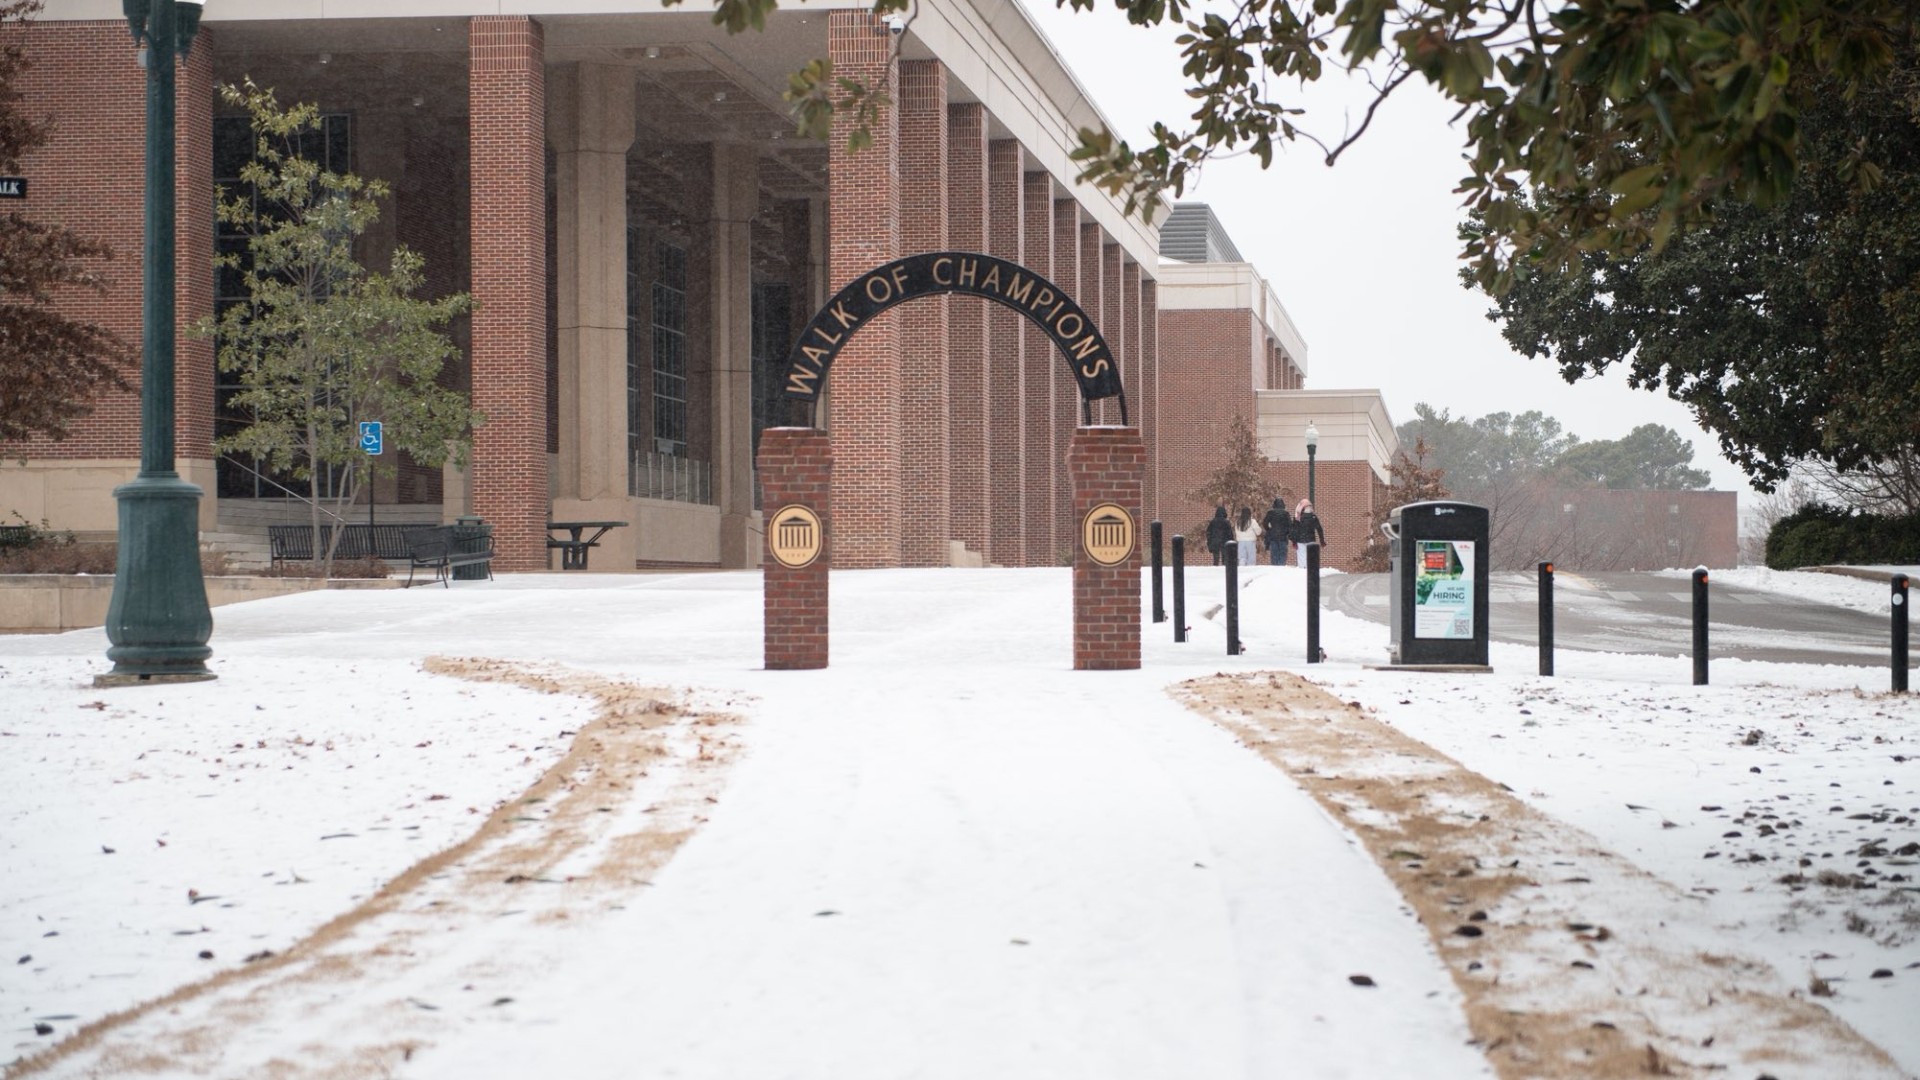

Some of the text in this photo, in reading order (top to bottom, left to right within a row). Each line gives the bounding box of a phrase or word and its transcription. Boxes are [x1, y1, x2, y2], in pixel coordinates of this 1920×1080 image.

[786, 257, 1109, 395] WALK OF CHAMPIONS
[1433, 592, 1465, 600] HIRING
